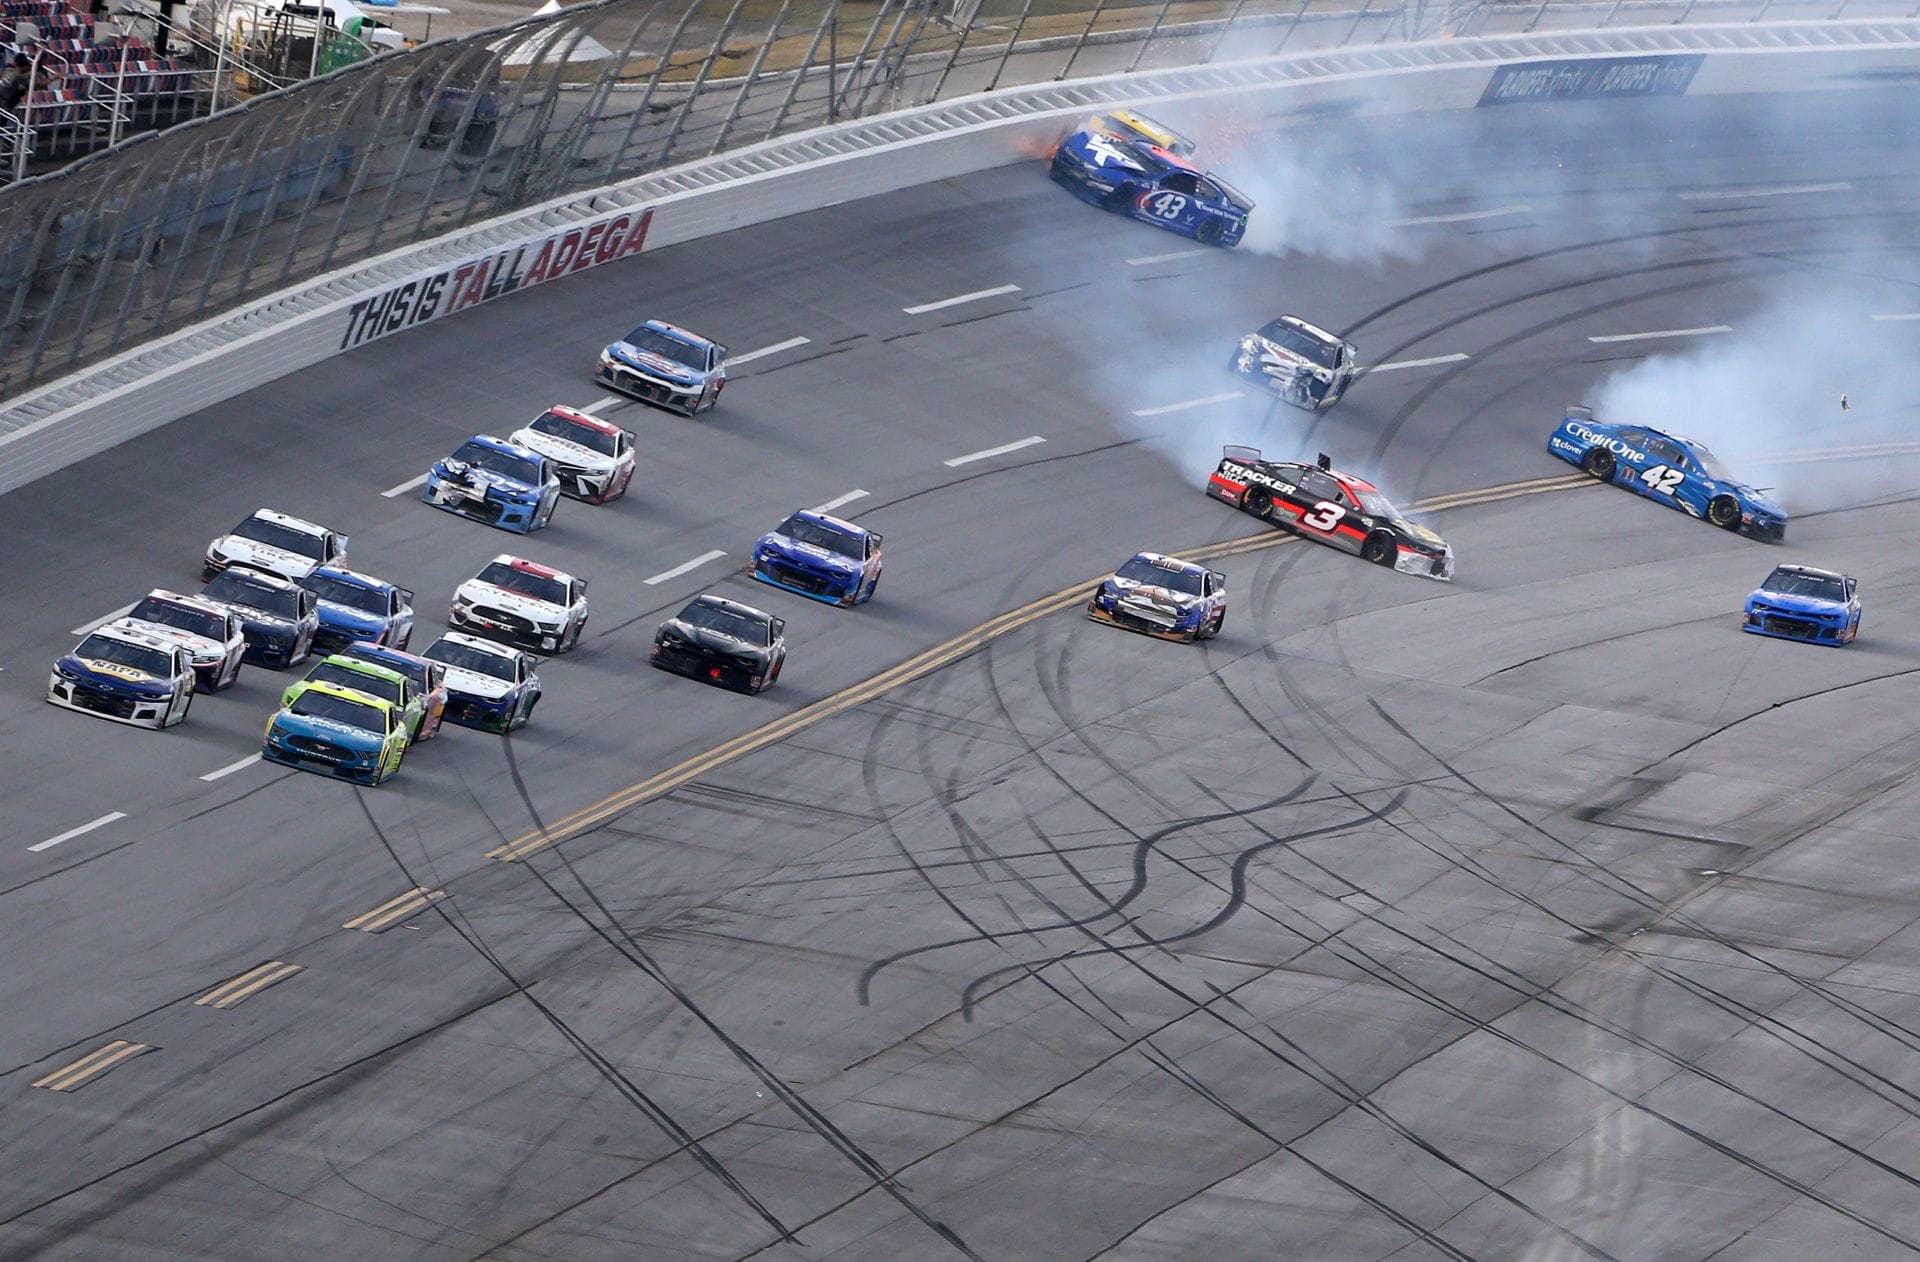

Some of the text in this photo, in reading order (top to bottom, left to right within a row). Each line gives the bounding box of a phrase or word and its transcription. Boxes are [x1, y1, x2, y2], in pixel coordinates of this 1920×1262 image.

[1496, 69, 1553, 98] PLAYOFFS
[1154, 194, 1186, 219] 43
[340, 205, 657, 350] THIS IS TALLADEGA
[1560, 441, 1583, 455] clover
[1222, 460, 1297, 495] TRACKER
[1641, 464, 1685, 496] 42
[1303, 501, 1346, 532] 3
[92, 660, 142, 678] NAPA
